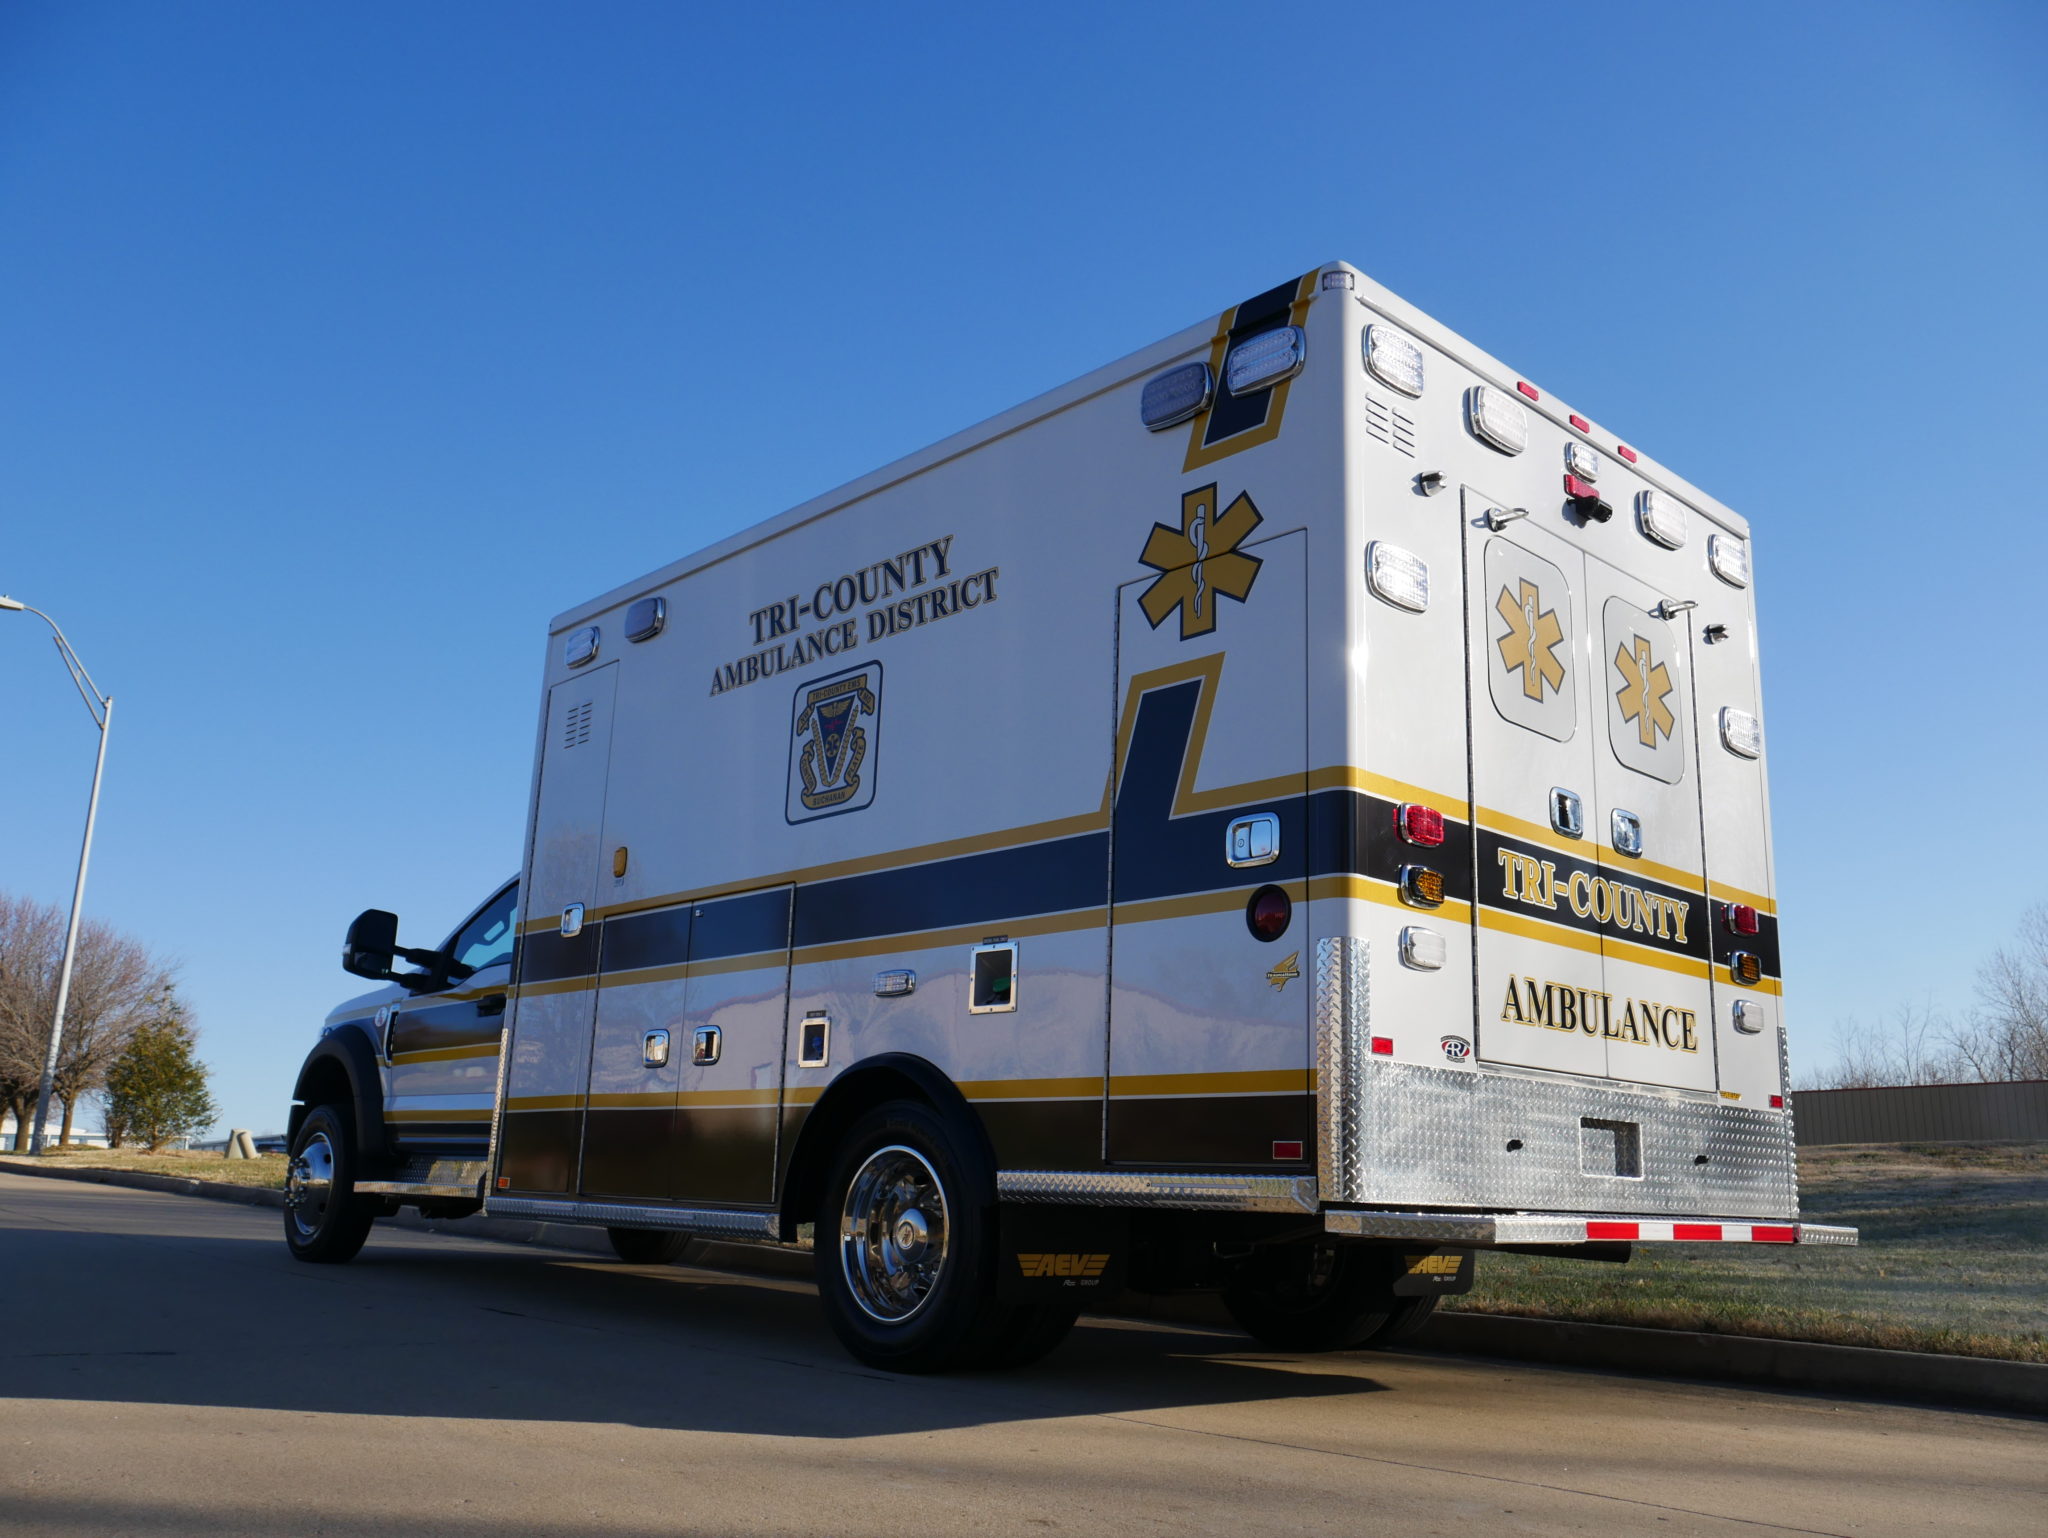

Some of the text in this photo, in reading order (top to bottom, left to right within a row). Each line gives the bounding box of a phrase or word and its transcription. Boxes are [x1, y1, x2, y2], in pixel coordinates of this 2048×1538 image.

[709, 565, 999, 698] AMBULANCE DISTRICT
[749, 534, 954, 646] TRI-COUNTY
[812, 678, 861, 701] TRI-COUNTY EMS
[1498, 847, 1689, 944] TRI-COUNTY
[1500, 973, 1698, 1054] AMBULANCE
